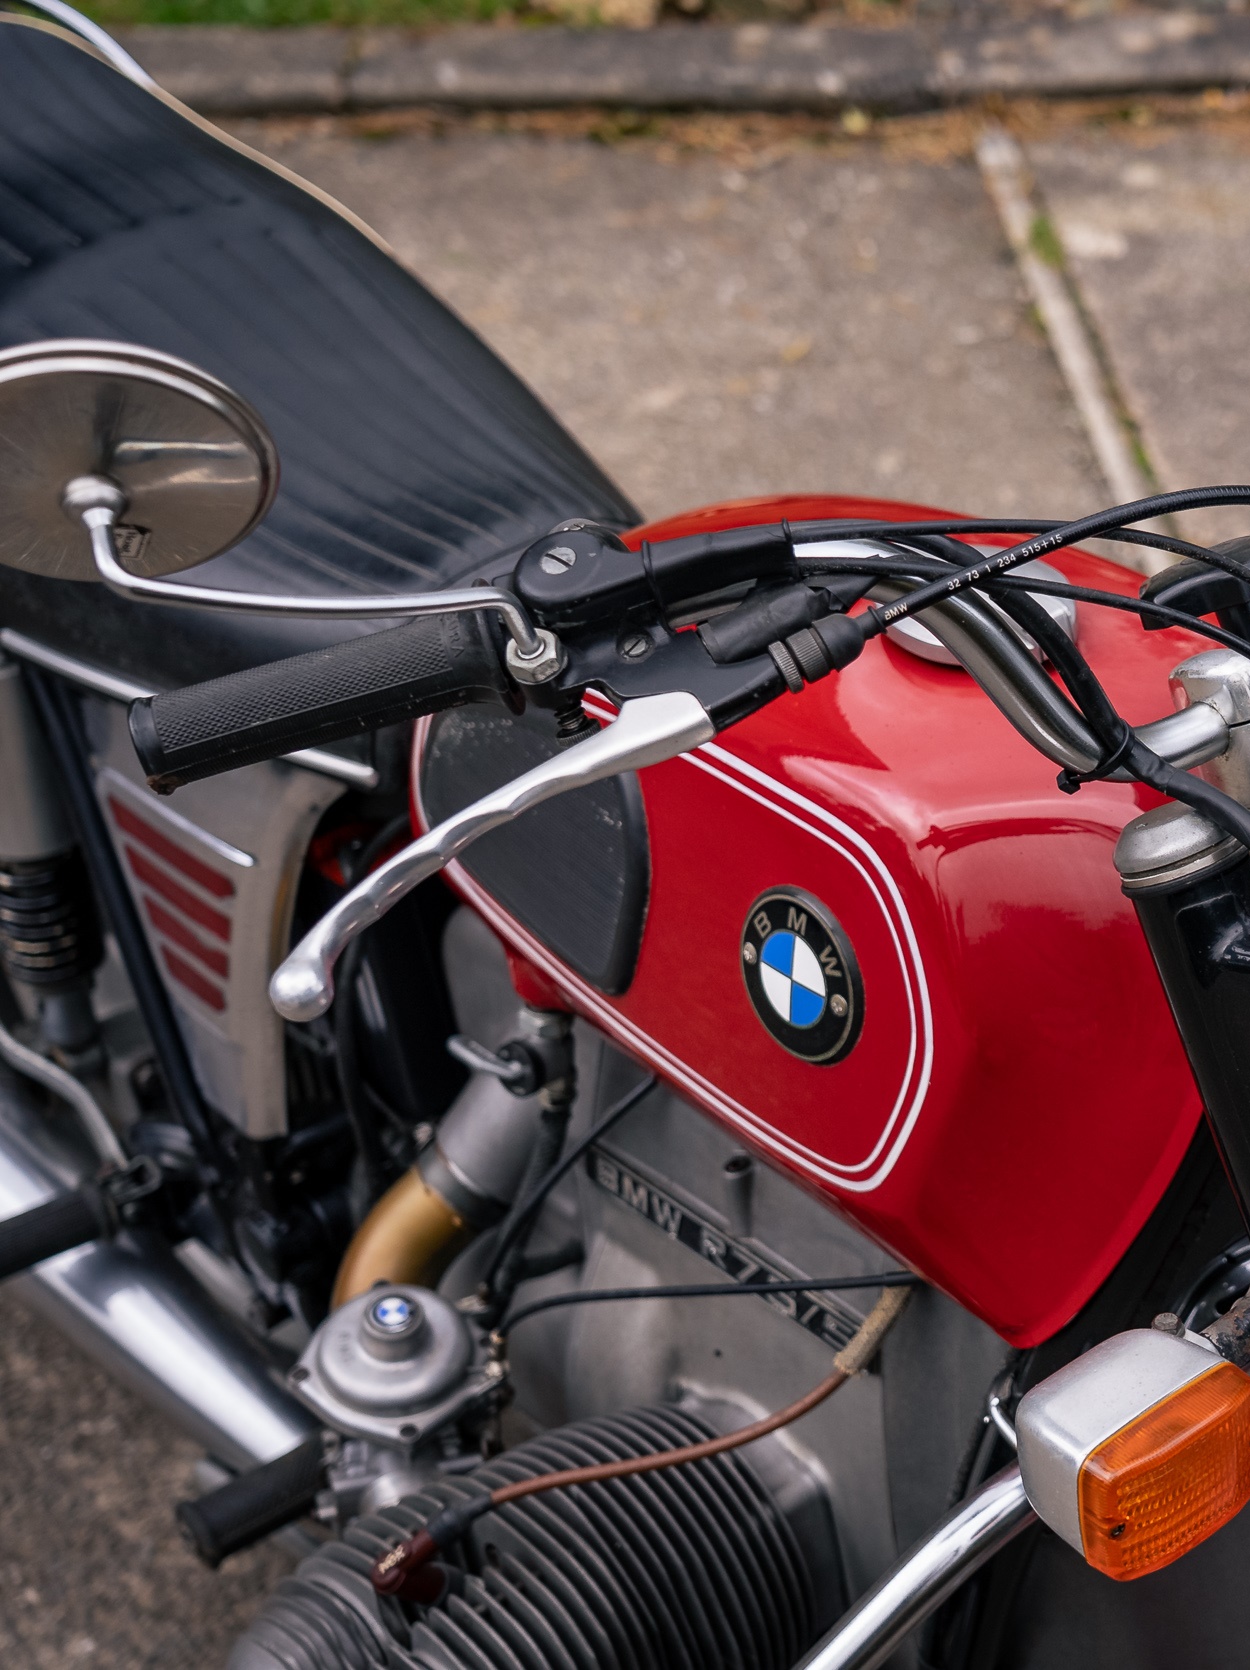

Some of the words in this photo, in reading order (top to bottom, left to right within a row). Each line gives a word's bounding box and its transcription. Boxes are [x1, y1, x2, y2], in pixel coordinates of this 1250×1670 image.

[884, 603, 908, 621] BMW
[947, 578, 961, 591] 32
[966, 570, 980, 582] 73
[985, 564, 992, 573] 1
[997, 553, 1016, 568] 234
[753, 907, 842, 978] BMW
[597, 1163, 683, 1239] BMW
